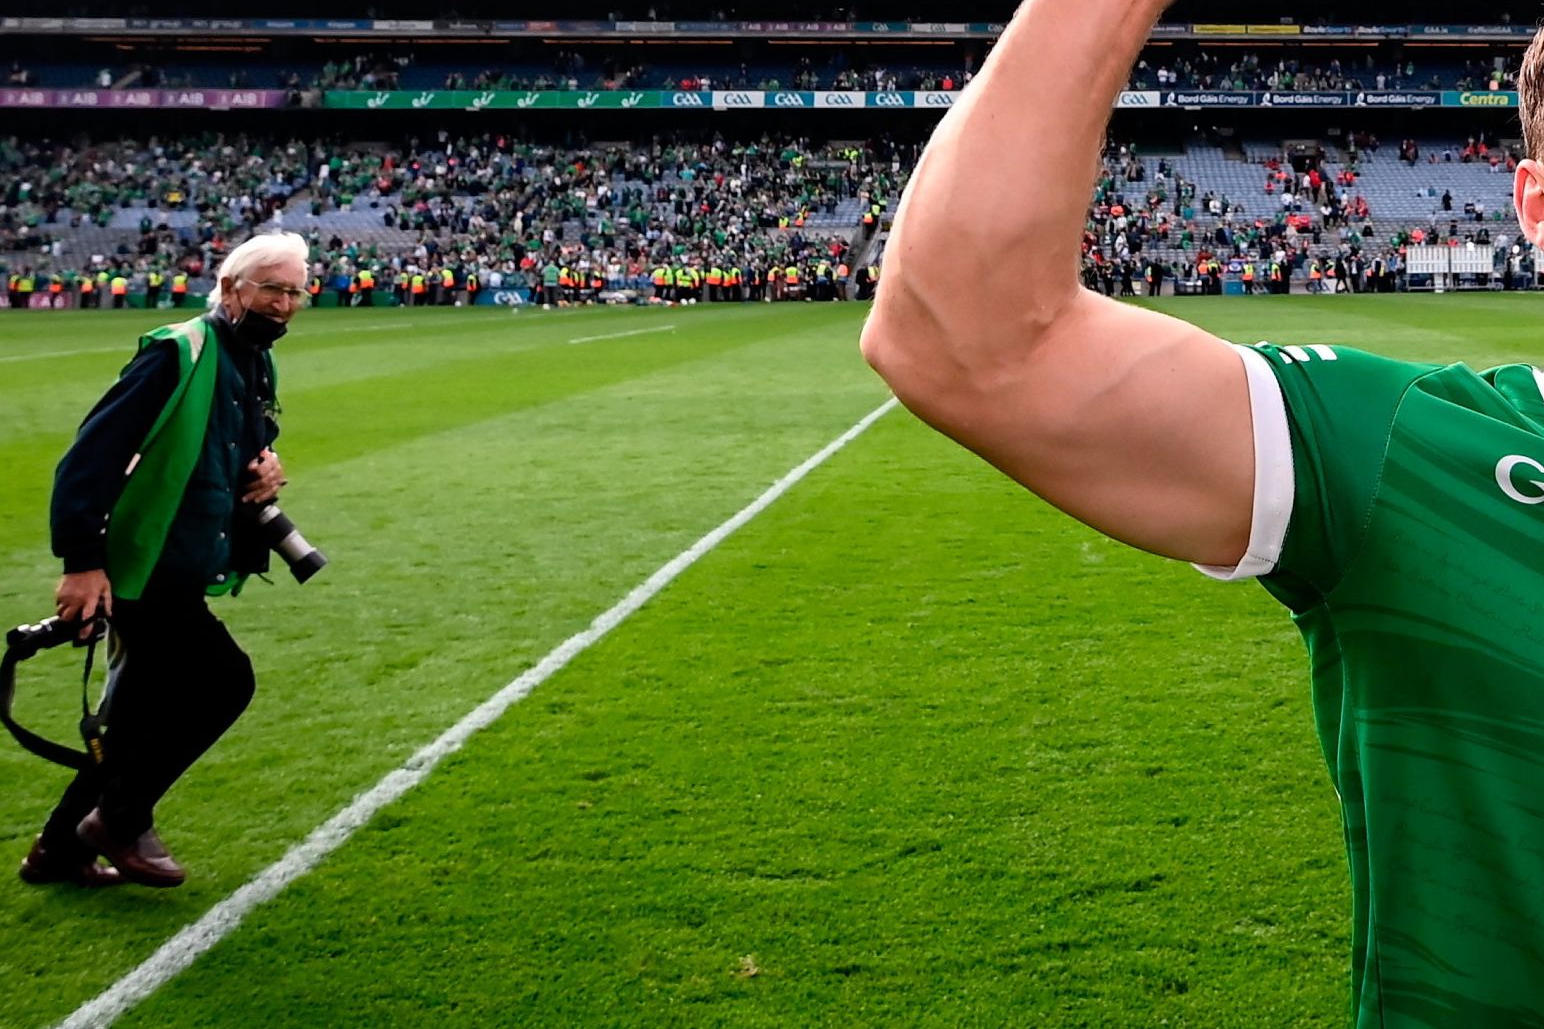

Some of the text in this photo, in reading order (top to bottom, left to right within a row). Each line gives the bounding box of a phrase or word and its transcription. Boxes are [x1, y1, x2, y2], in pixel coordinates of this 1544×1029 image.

[20, 92, 44, 106] AIB
[72, 92, 97, 106] AIB
[126, 92, 150, 106] AIB
[179, 92, 204, 106] AIB
[233, 92, 257, 106] AIB
[367, 92, 390, 108] eir
[412, 92, 434, 108] eir
[473, 92, 495, 108] eir
[517, 92, 539, 108] eir
[577, 92, 599, 108] eir
[621, 92, 643, 108] eir
[1178, 94, 1198, 104] Bord
[1218, 94, 1248, 105] Energy
[1273, 94, 1294, 104] Bord
[1314, 94, 1342, 105] Energy
[1366, 94, 1388, 104] Bord
[1406, 94, 1435, 105] Energy
[1460, 92, 1509, 105] Centra
